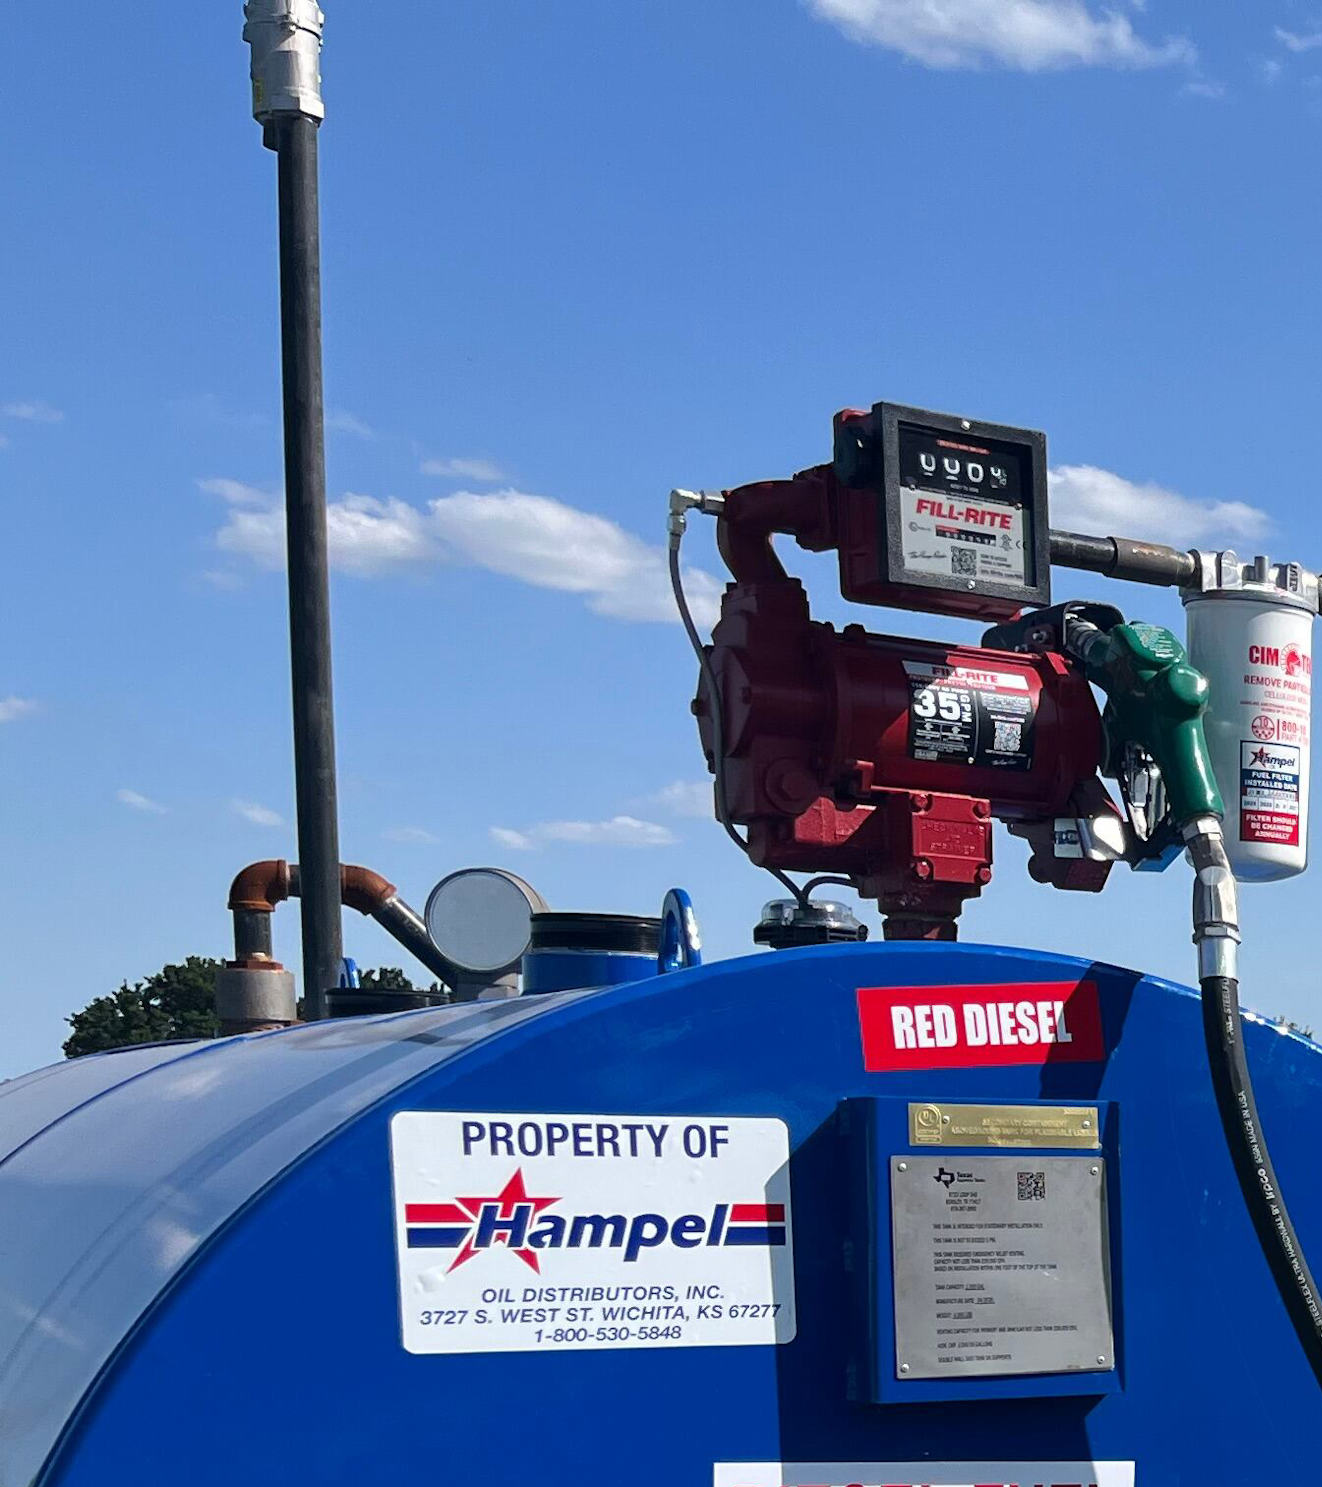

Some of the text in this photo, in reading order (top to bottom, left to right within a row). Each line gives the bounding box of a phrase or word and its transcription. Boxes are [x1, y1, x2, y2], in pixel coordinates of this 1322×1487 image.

[916, 498, 1012, 530] FILL-RITE
[1249, 645, 1279, 667] CIM
[1243, 674, 1282, 688] REMOVE
[913, 688, 961, 721] 35
[959, 694, 973, 723] GPM
[1252, 771, 1271, 780] FUEL
[890, 1000, 1073, 1050] RED DIESEL
[1237, 1089, 1248, 1108] USA
[461, 1120, 729, 1158] PROPERTY OF
[1269, 1202, 1280, 1216] BY
[473, 1203, 729, 1262] Hampel
[1289, 1258, 1306, 1285] ULTRA
[481, 1285, 725, 1304] OIL DISTRIBUTORS, INC.
[420, 1304, 782, 1326] 3727 S. WEST ST. WICHITA, KS 67277
[534, 1326, 682, 1343] 1-800-530-5848
